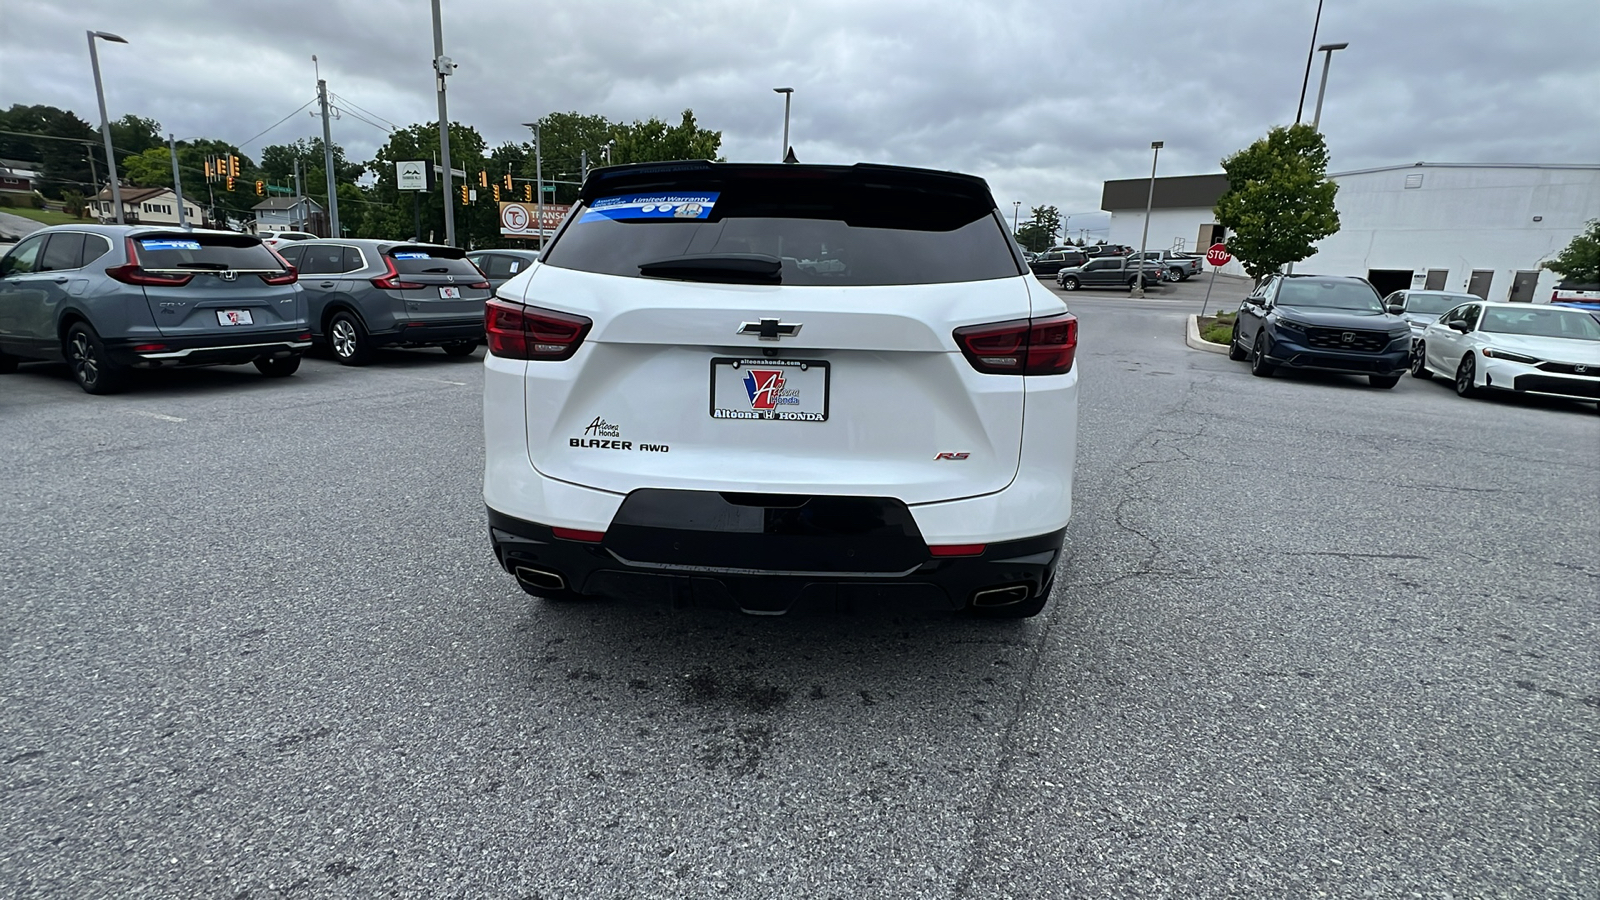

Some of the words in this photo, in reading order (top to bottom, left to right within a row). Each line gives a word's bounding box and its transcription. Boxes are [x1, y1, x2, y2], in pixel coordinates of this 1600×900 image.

[1208, 250, 1231, 260] STOP
[771, 395, 799, 405] Honda
[713, 409, 760, 419] Altoona
[779, 412, 825, 421] HONDA
[569, 438, 633, 450] BLAZER
[639, 443, 669, 453] AWD
[933, 452, 970, 460] RS
